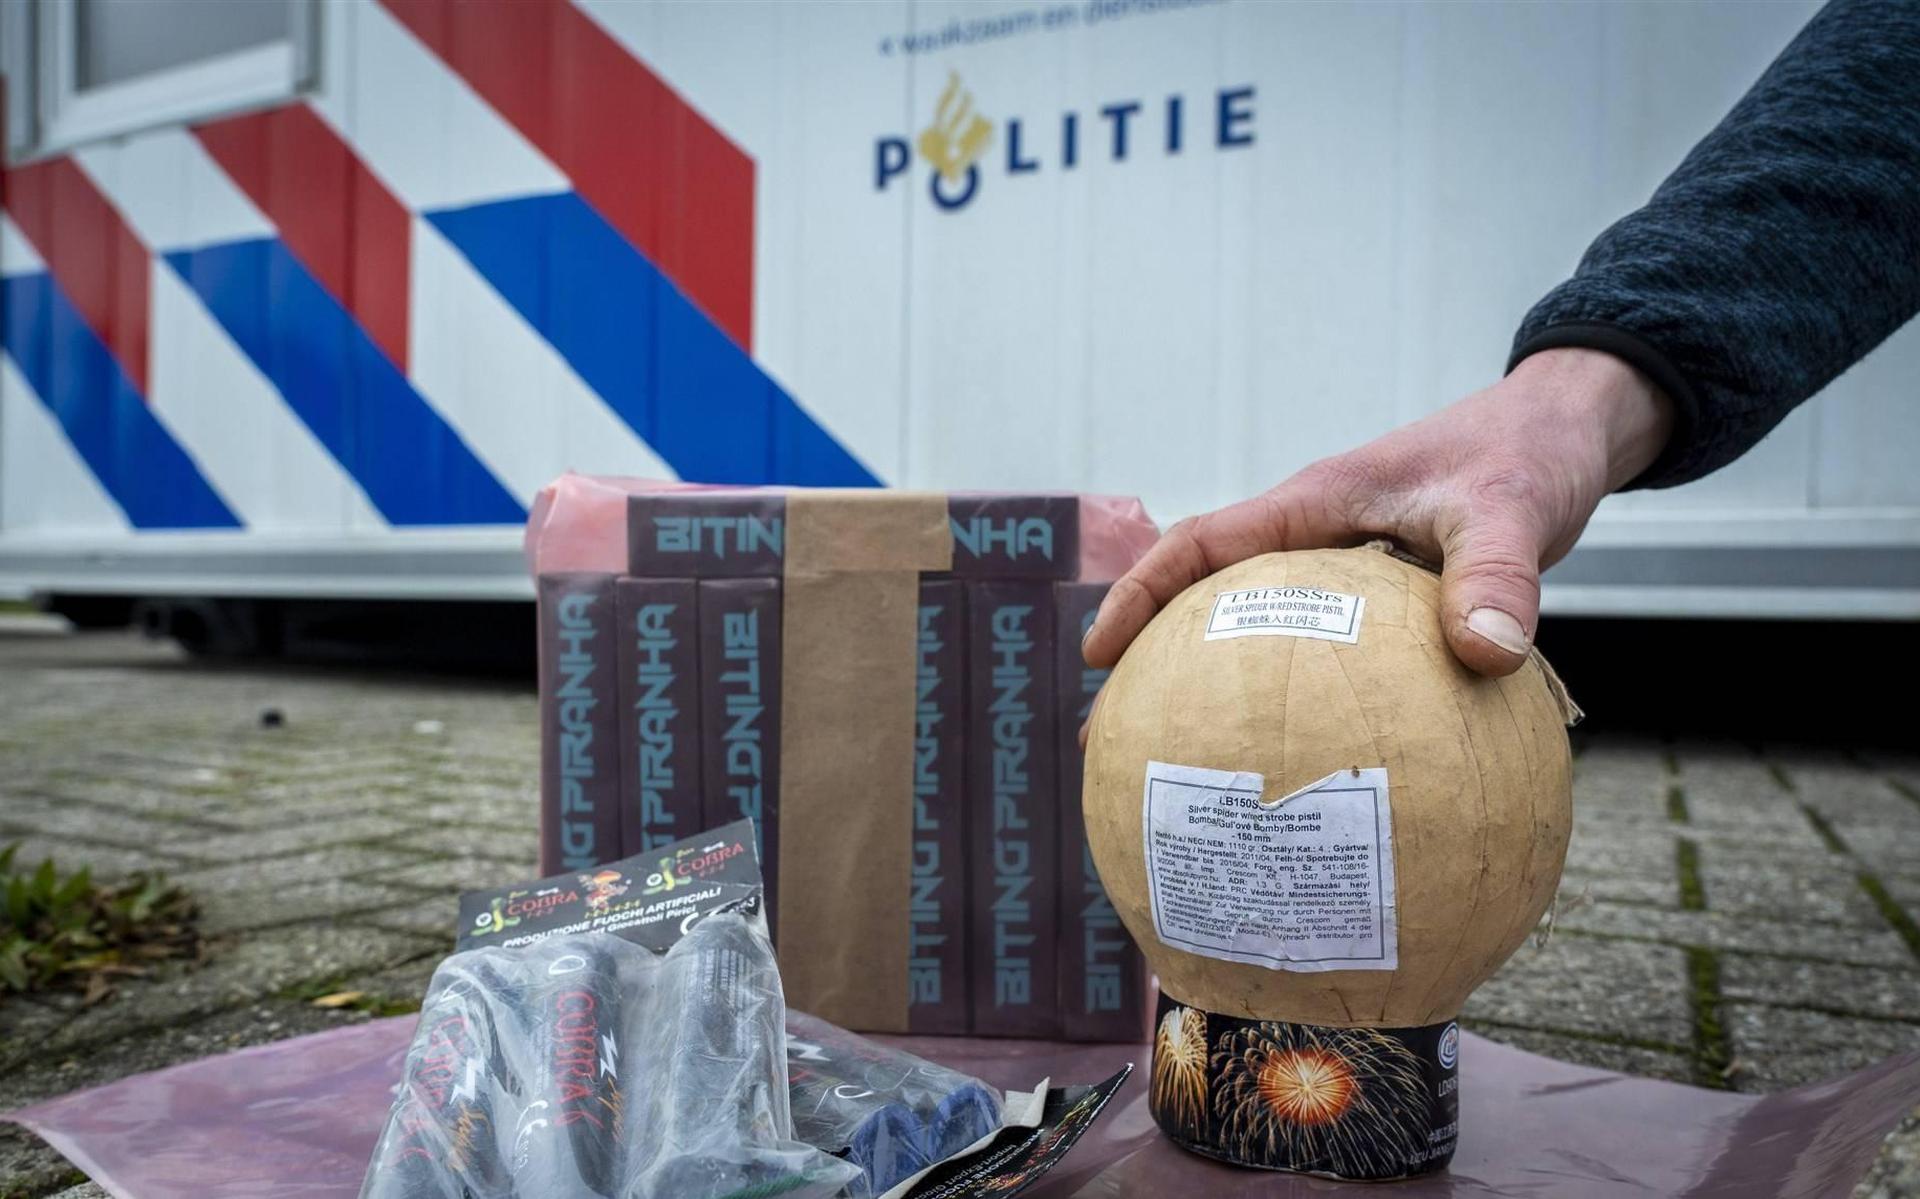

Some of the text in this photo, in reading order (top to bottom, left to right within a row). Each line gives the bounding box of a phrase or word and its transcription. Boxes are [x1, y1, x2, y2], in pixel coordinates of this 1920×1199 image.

[652, 516, 783, 560] BITIN
[557, 593, 598, 812] PIRANHA
[635, 603, 679, 824] PIRANHA
[988, 605, 1037, 1006] BITING PIRANHA
[1188, 805, 1211, 813] Silver
[1213, 807, 1239, 818] spider
[1266, 812, 1295, 821] strobe
[1298, 812, 1321, 822] pistil
[1237, 833, 1252, 841] 150
[1254, 834, 1271, 842] mm
[1254, 823, 1321, 834] Bomby/Bombe
[677, 842, 744, 876] COBRA
[1357, 852, 1369, 860] do
[507, 891, 578, 916] COBRA
[592, 909, 645, 928] FUOCHI
[645, 887, 722, 916] ARTIFICIALI
